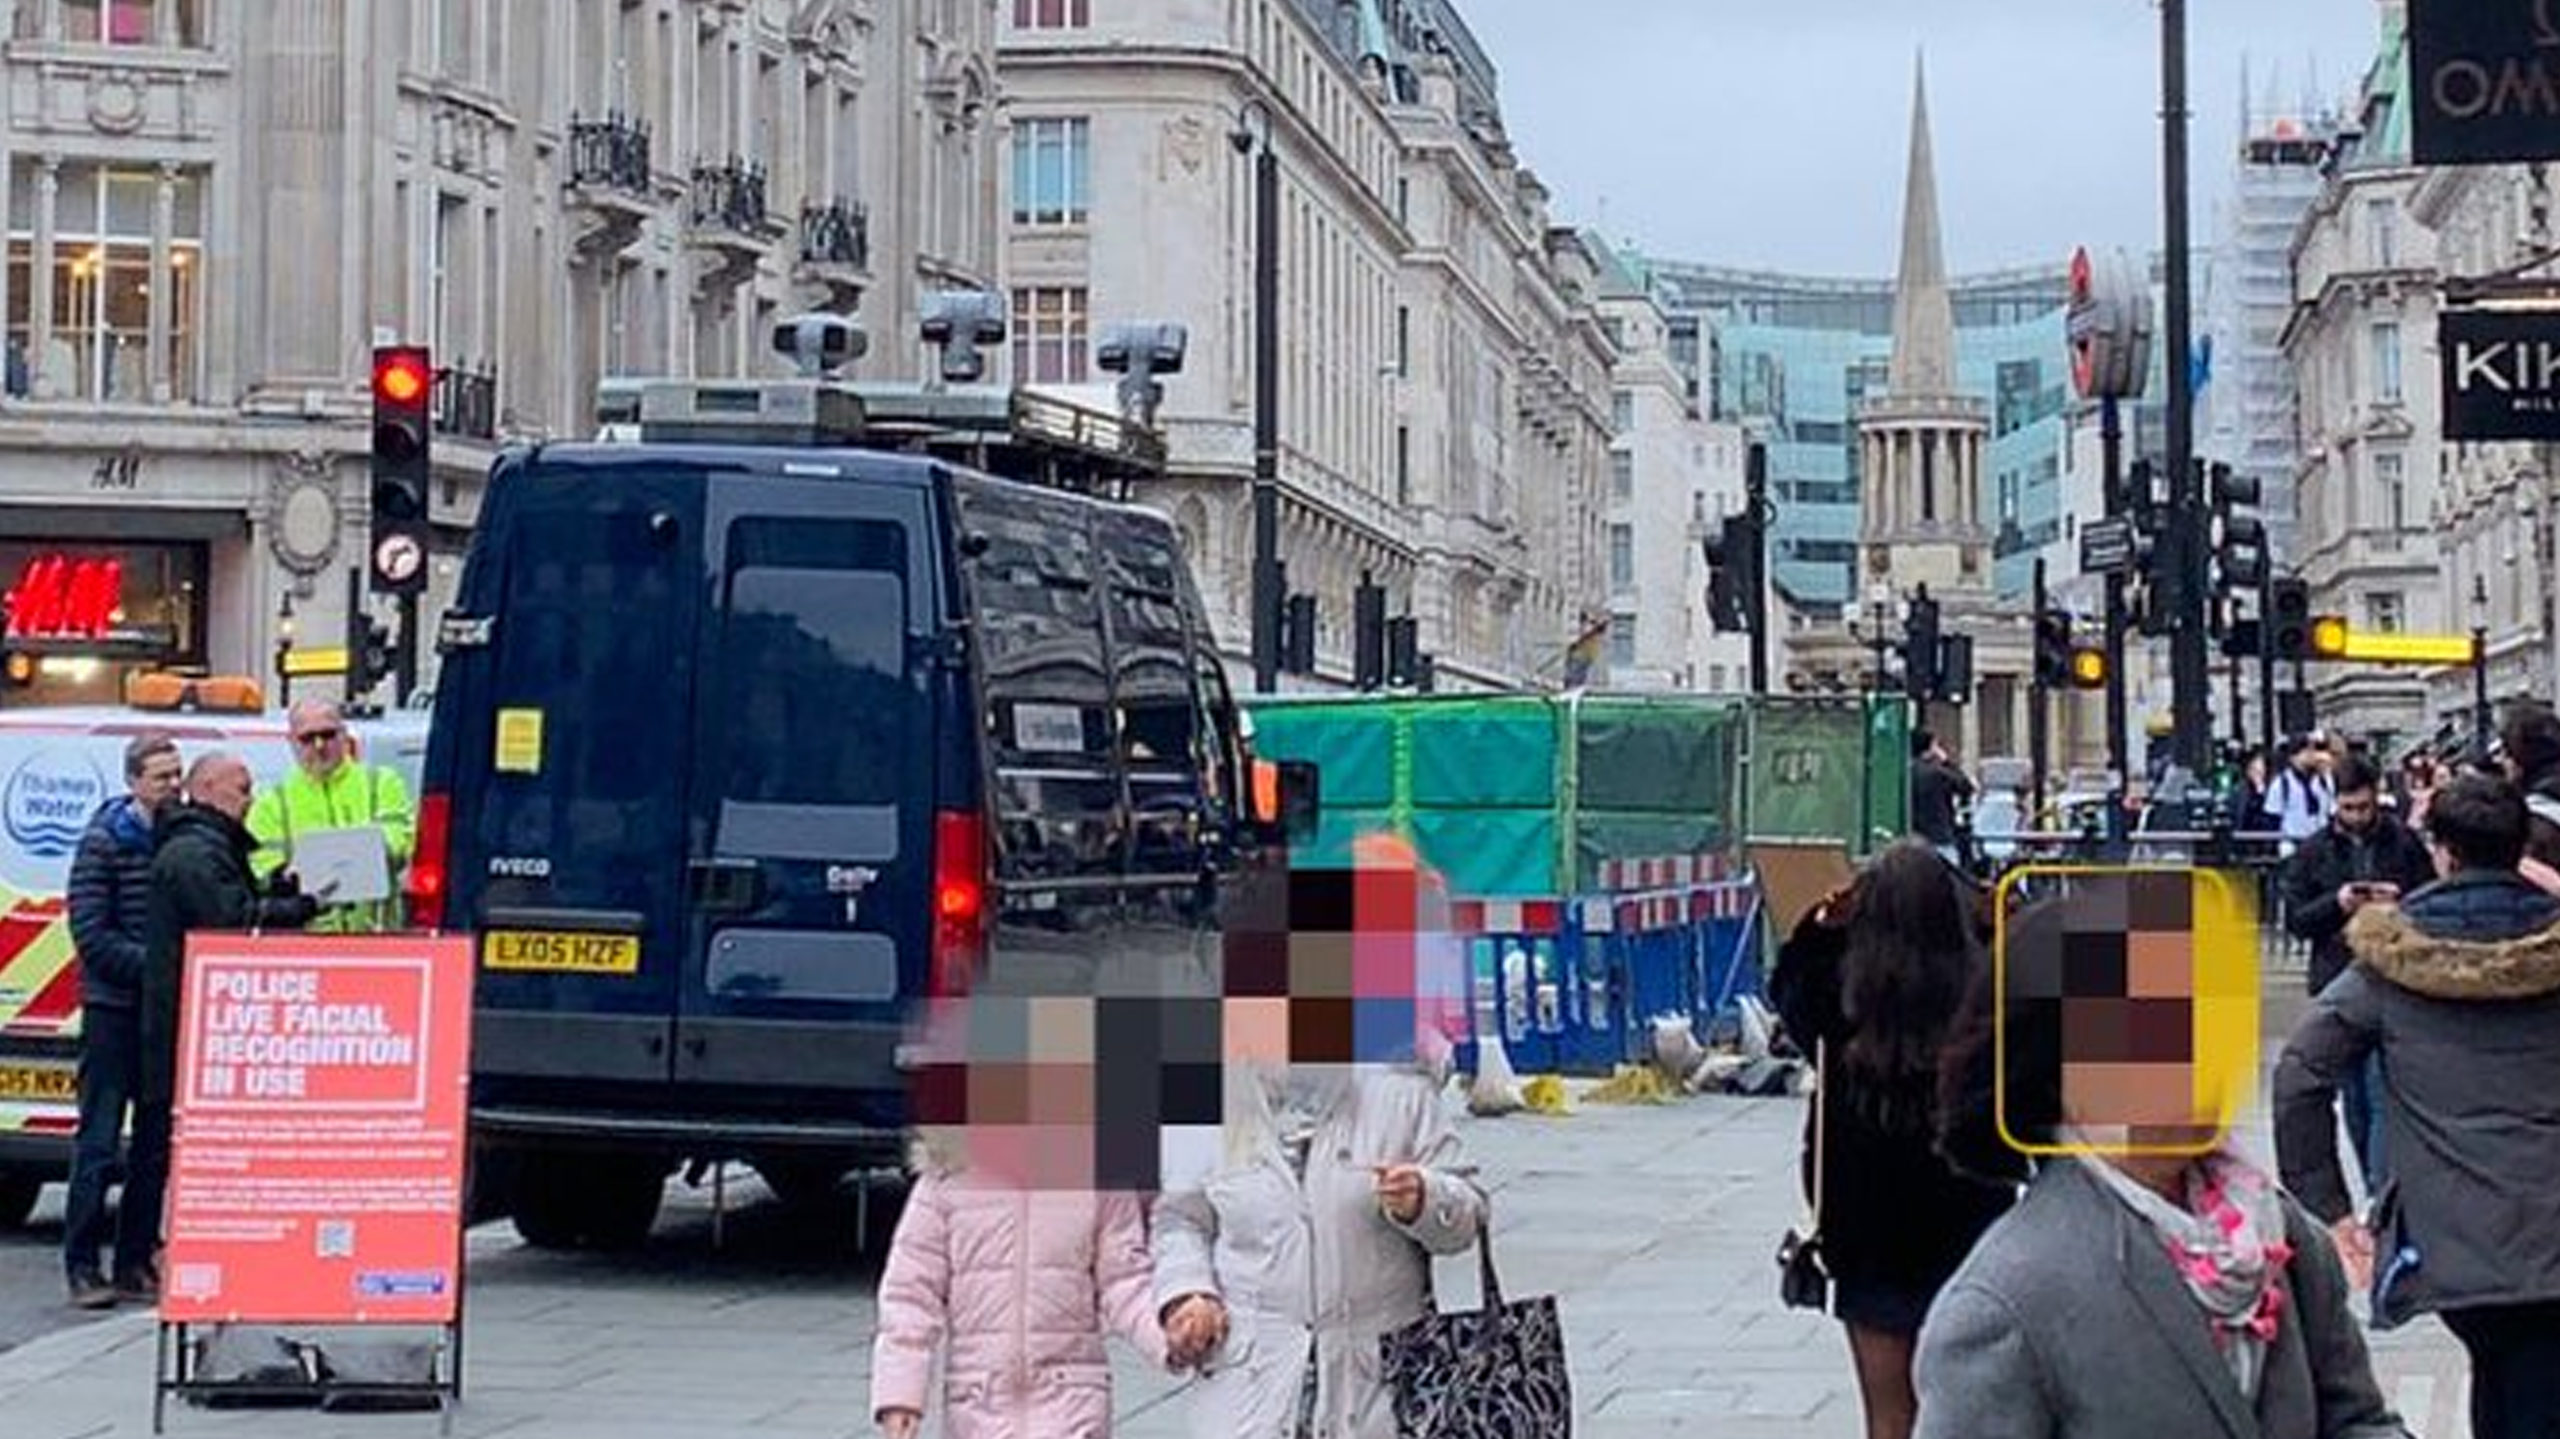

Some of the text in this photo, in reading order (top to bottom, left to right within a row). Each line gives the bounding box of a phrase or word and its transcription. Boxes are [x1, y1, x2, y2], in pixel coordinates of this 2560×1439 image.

[23, 774, 96, 796] Thames
[25, 799, 85, 818] Water
[573, 937, 627, 967] HZF
[207, 970, 320, 1000] POLICE
[206, 1003, 390, 1034] LIVE FACIAL
[204, 1034, 413, 1065] RECOGNITION
[202, 1066, 306, 1097] IN USE
